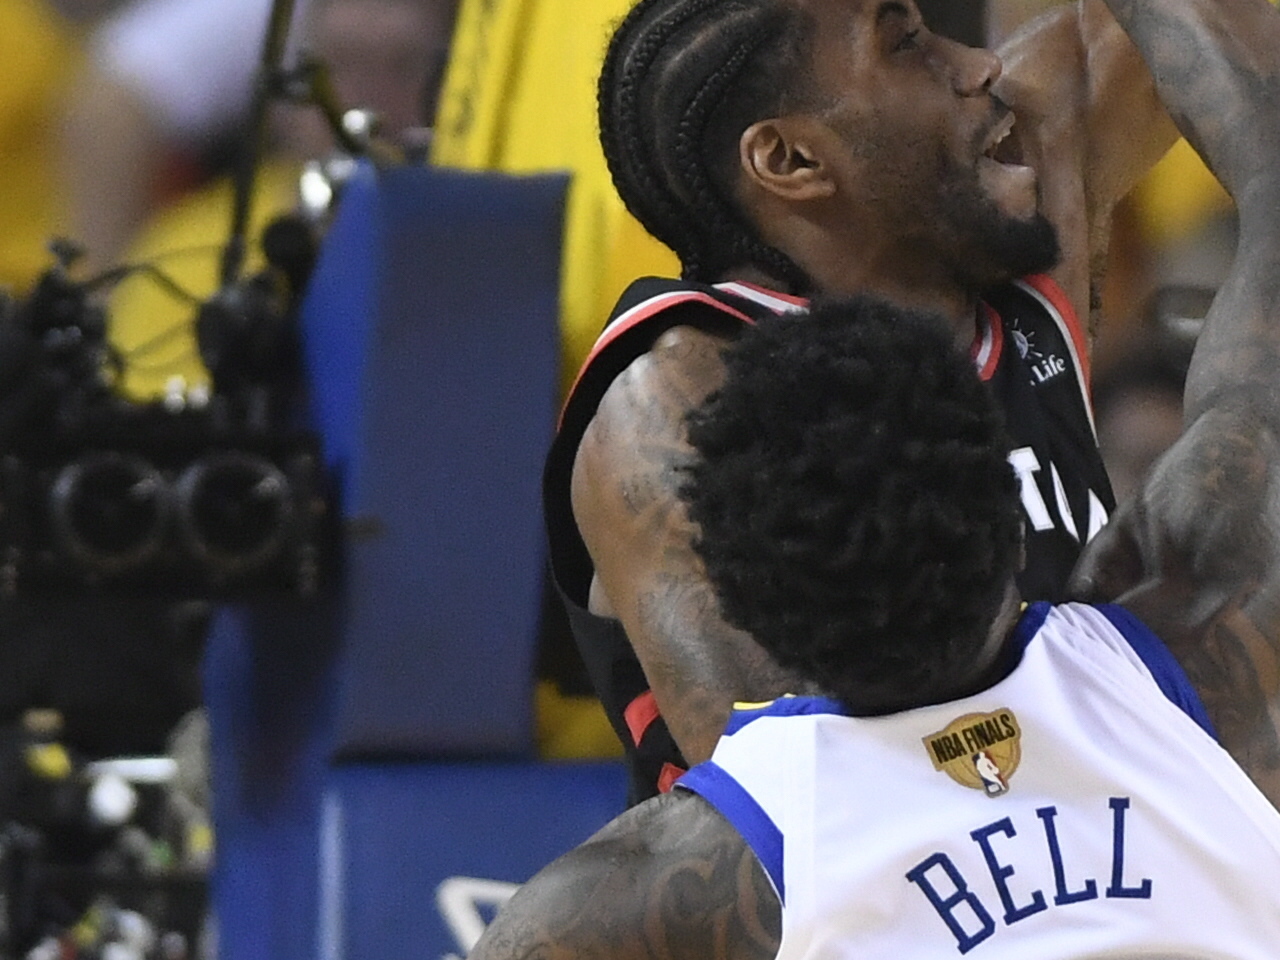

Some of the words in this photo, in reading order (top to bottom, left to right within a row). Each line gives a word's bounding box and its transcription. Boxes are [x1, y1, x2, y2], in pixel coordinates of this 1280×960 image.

[1031, 353, 1066, 384] Life
[930, 732, 968, 764] NBA
[961, 713, 1016, 754] FINALS
[904, 796, 1153, 956] BELL
